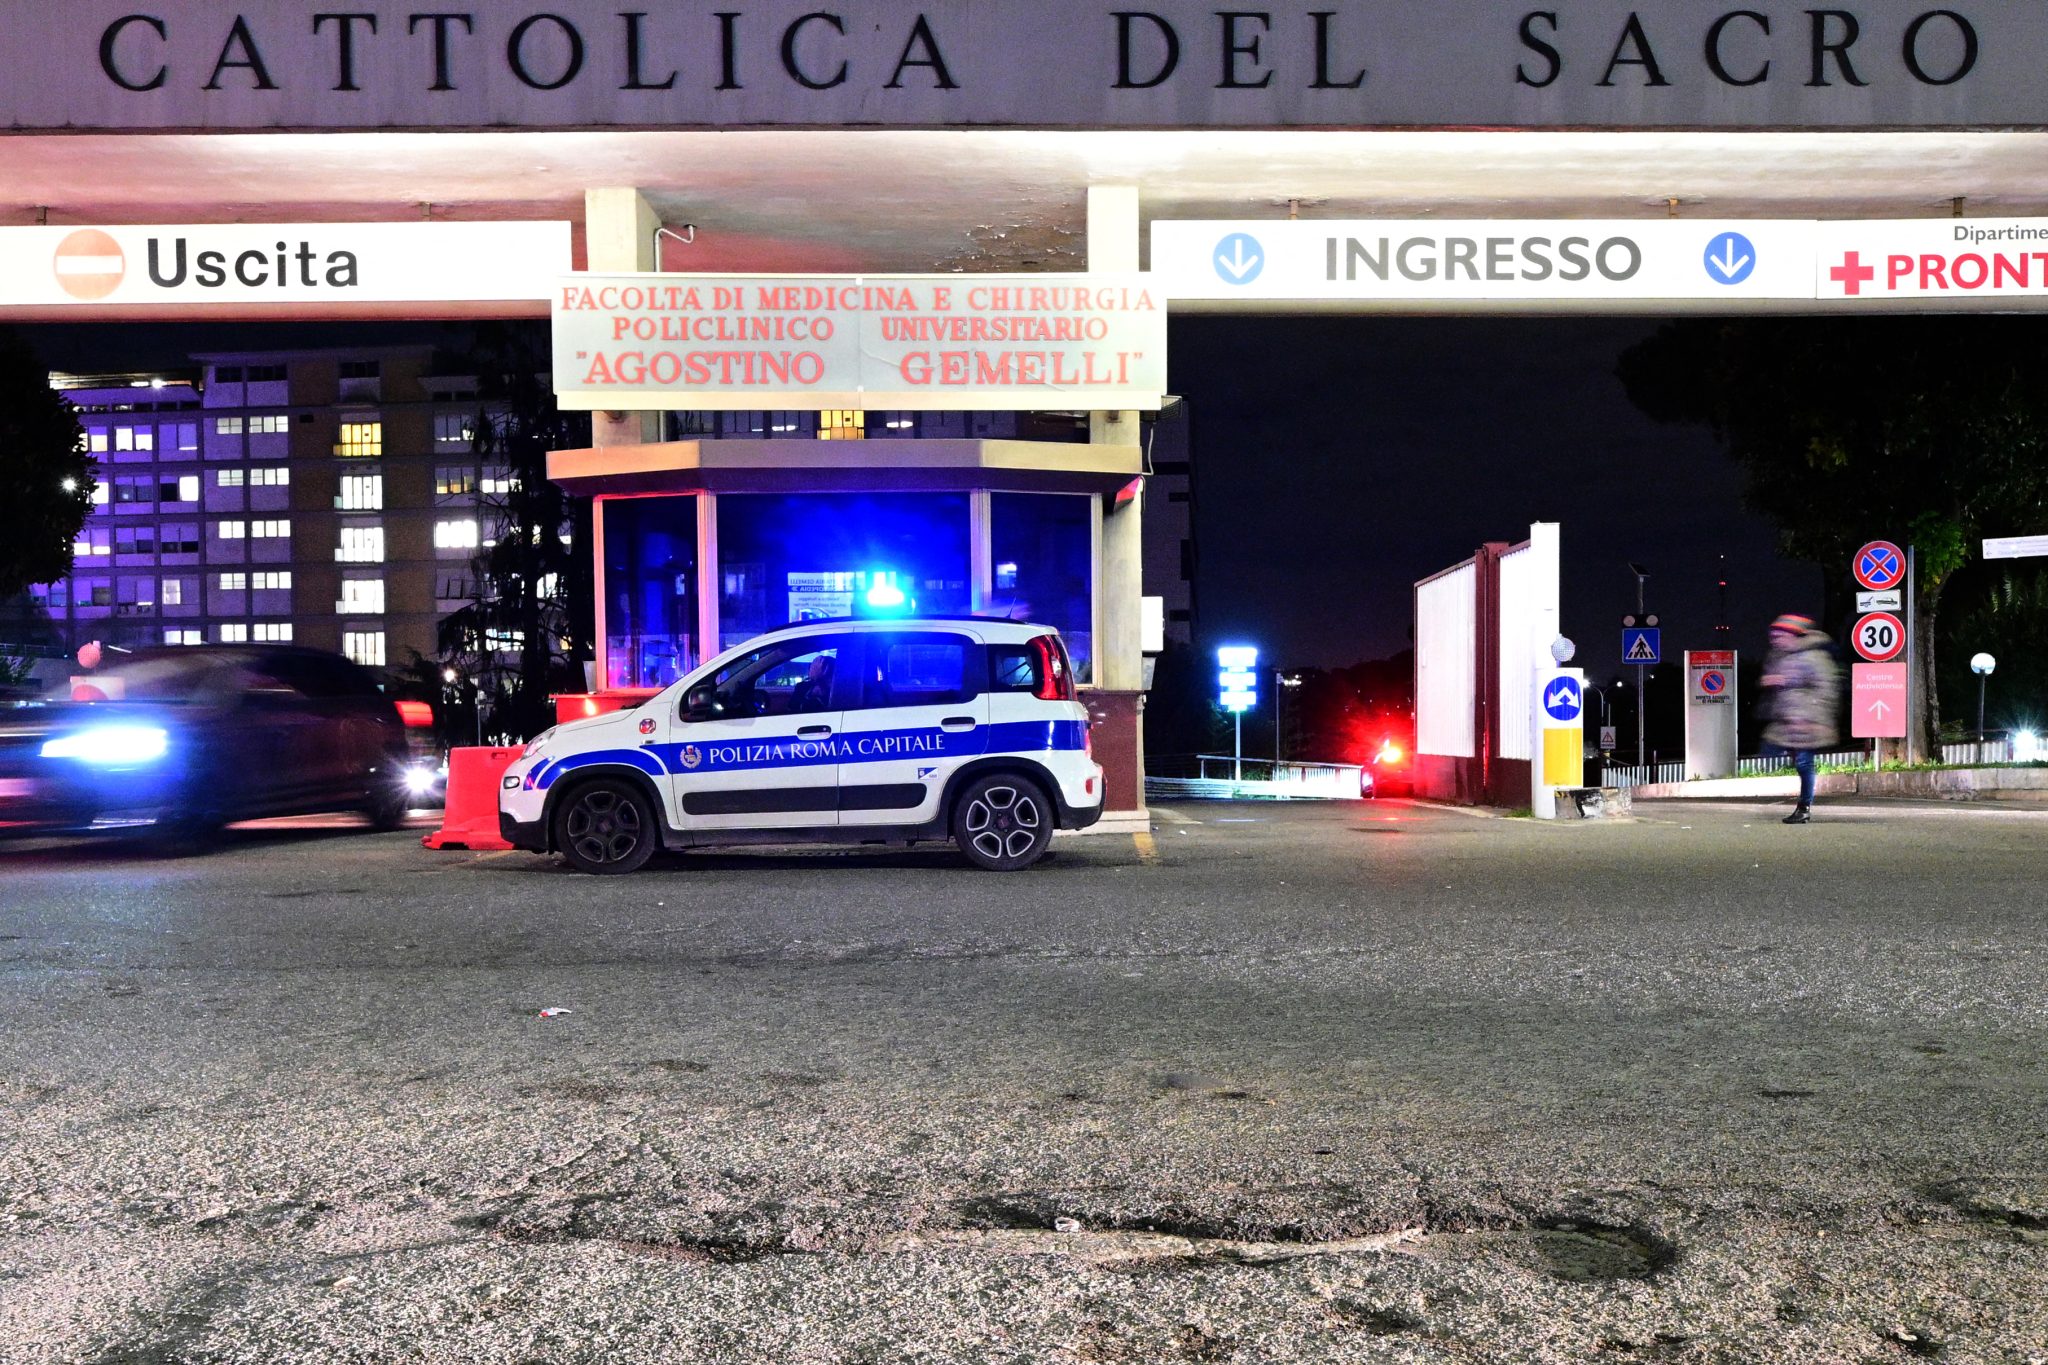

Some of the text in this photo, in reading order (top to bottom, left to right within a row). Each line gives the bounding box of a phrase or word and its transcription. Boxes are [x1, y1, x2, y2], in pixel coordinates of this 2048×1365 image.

[99, 10, 1978, 91] CATTOLICA DEL SACRO
[147, 238, 358, 288] Uscita
[1326, 237, 1642, 281] INGRESSO
[713, 287, 744, 311] DI
[758, 287, 918, 311] MEDICINA
[932, 287, 952, 311] E
[967, 286, 1156, 311] CHIRURGIA
[612, 316, 1109, 341] POLICLINICO UNIVERSITARIO
[1864, 625, 1893, 648] 30
[1866, 673, 1894, 681] Centro
[709, 734, 945, 764] POLIZIA ROMA CAPITALE
